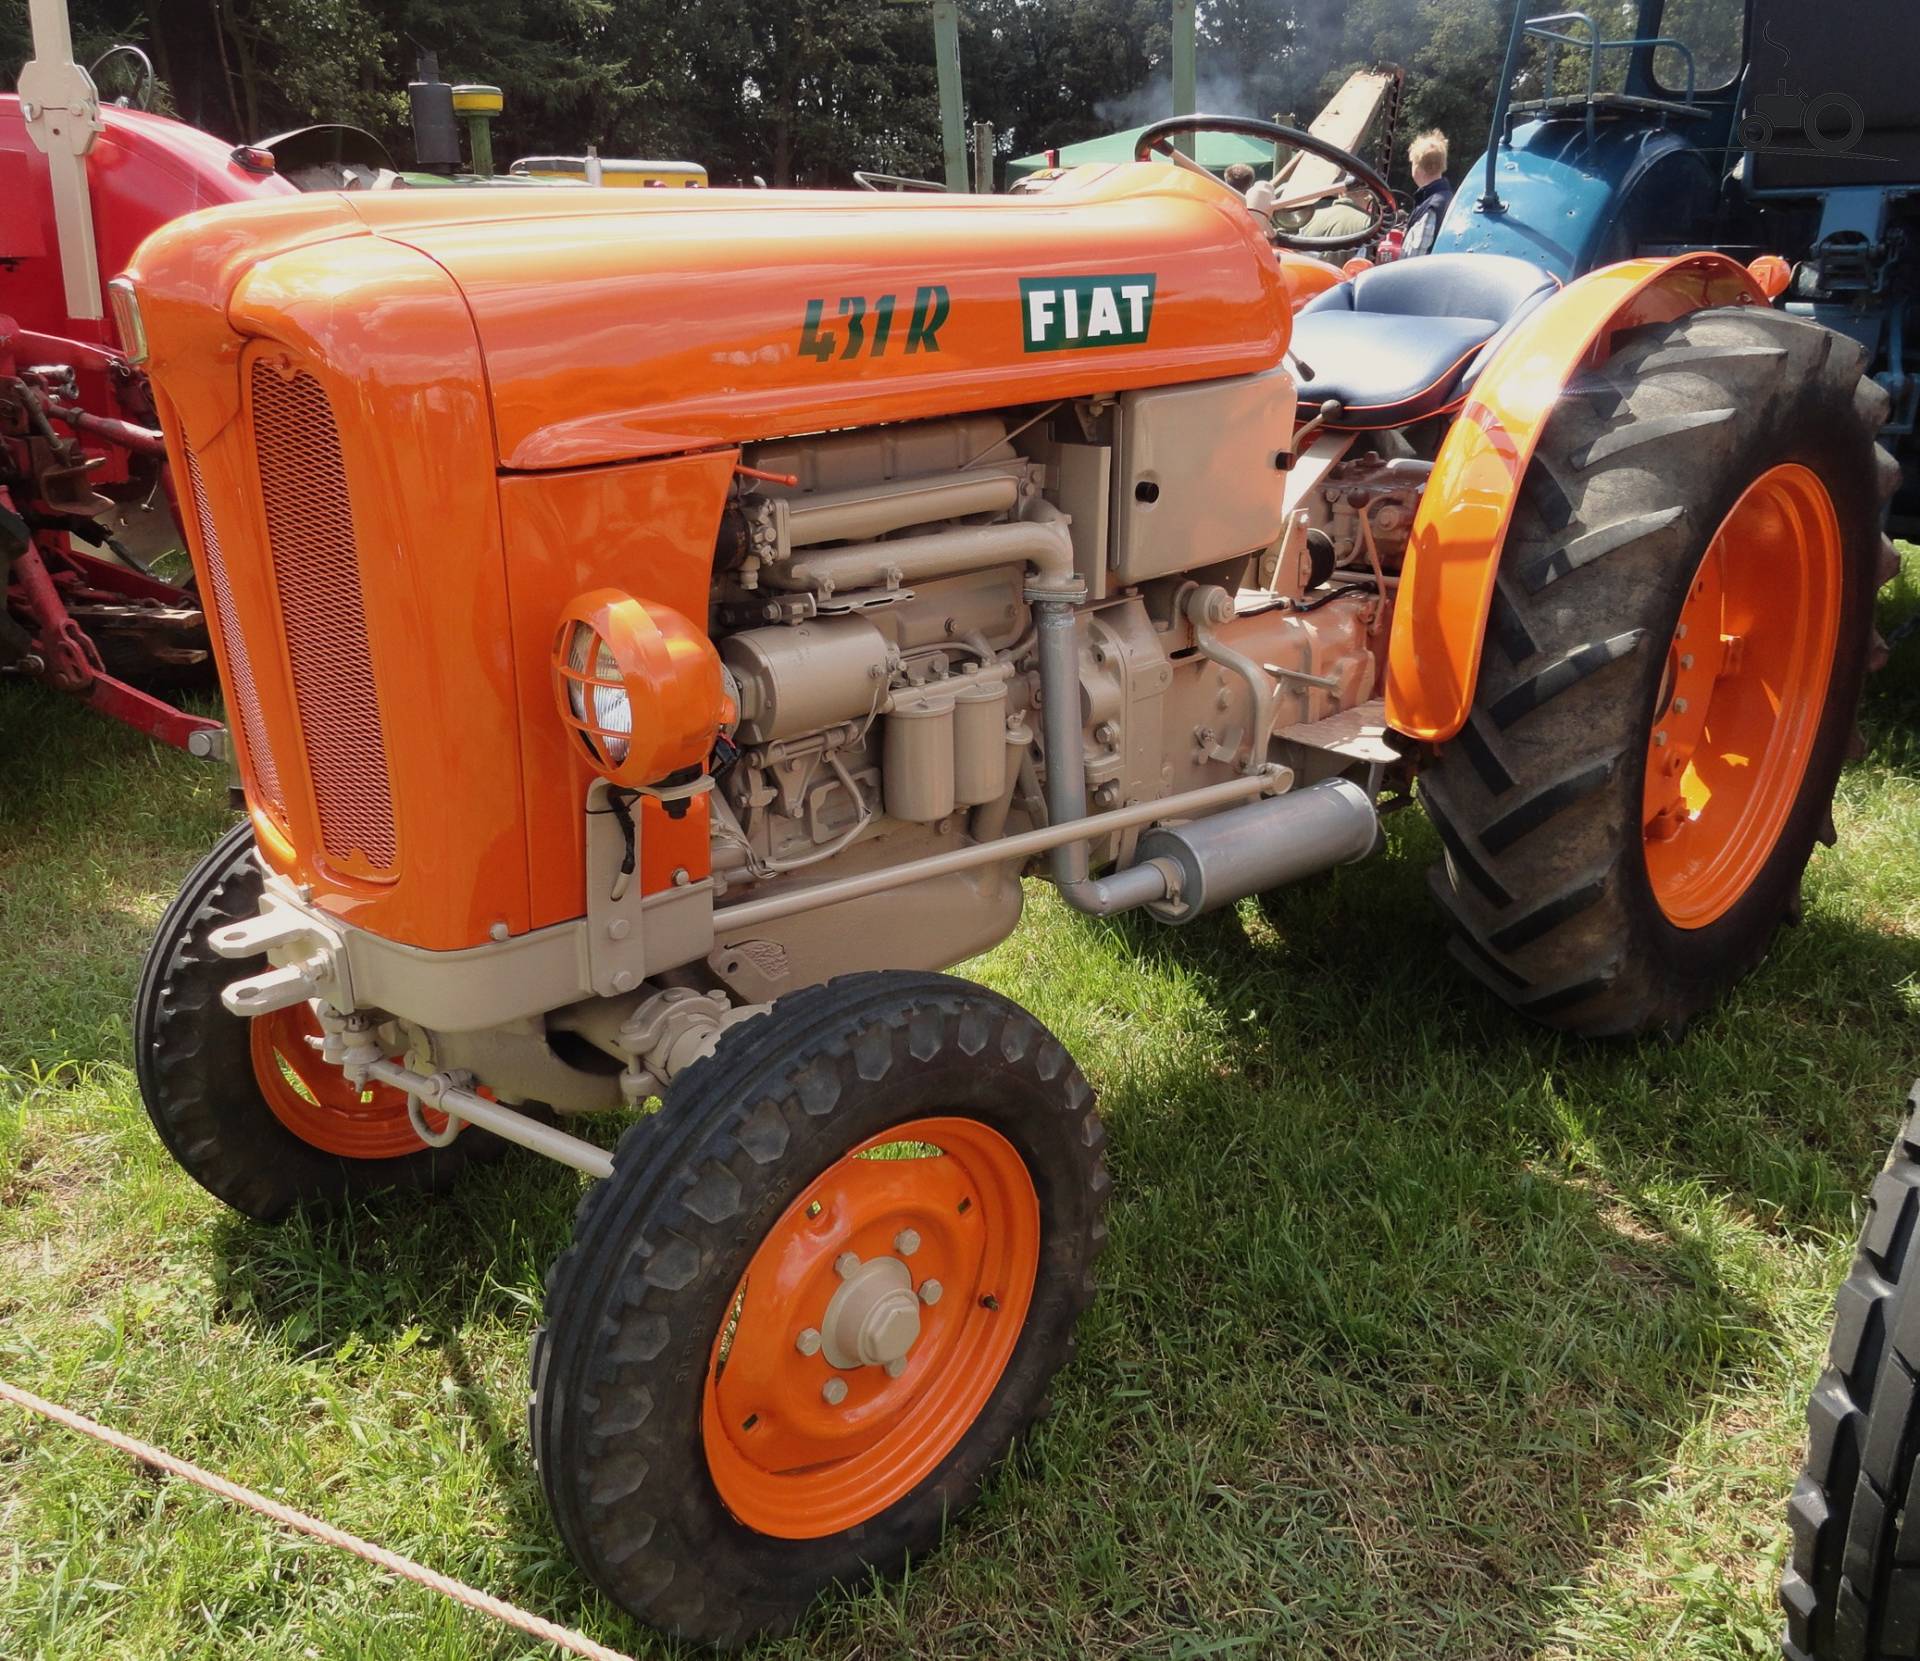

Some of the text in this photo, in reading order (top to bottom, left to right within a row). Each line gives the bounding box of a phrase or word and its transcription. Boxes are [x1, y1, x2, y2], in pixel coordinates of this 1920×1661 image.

[797, 285, 950, 362] 431 R
[1028, 285, 1149, 342] FIAT
